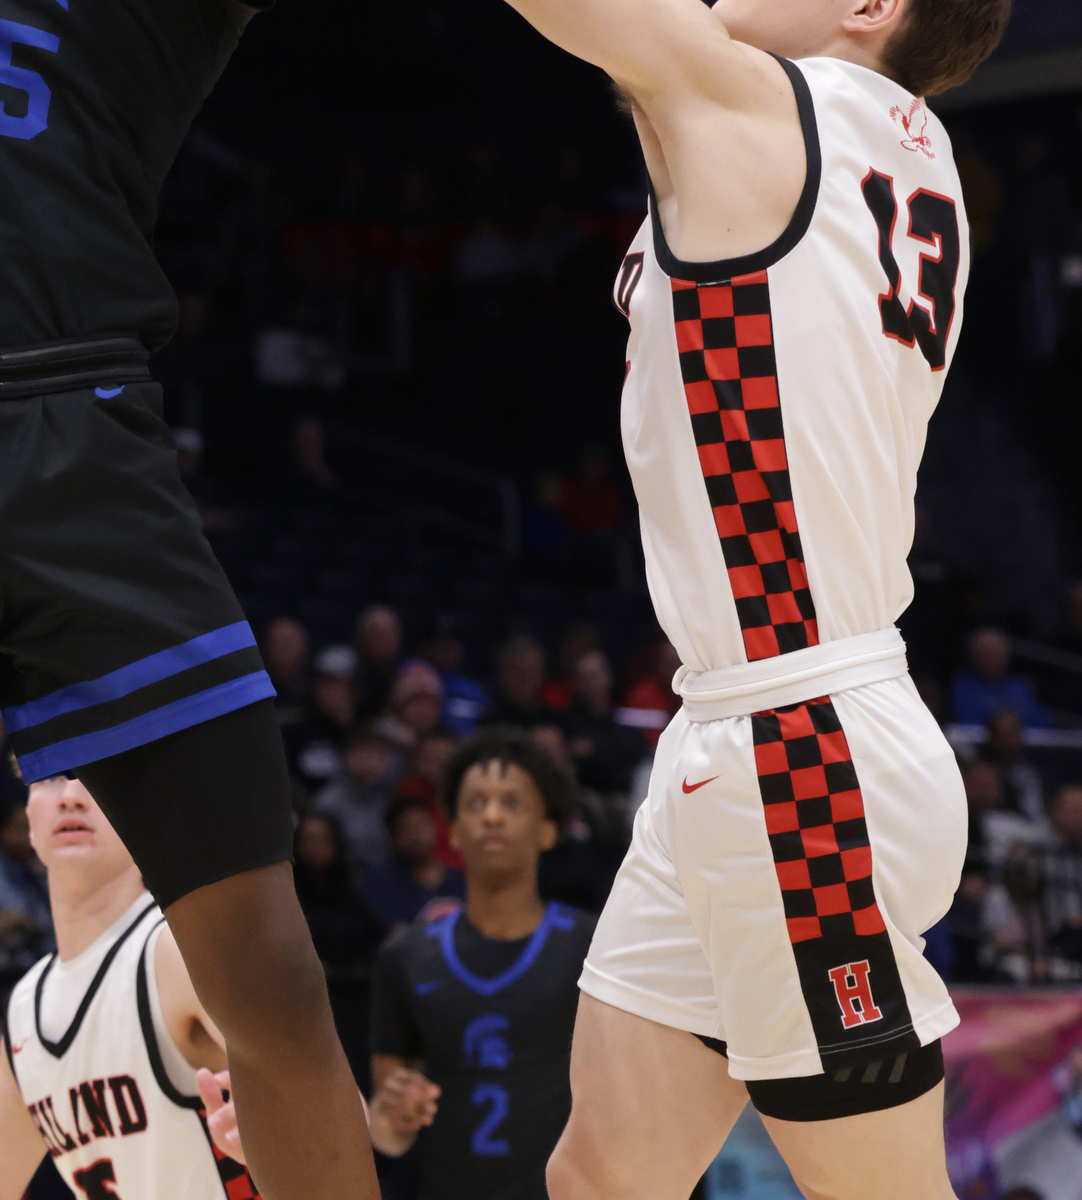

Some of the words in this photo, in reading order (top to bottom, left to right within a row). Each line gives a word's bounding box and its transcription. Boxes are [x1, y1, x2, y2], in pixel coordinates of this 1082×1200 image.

[860, 165, 961, 372] 13
[827, 958, 884, 1029] H
[471, 1083, 512, 1156] 2
